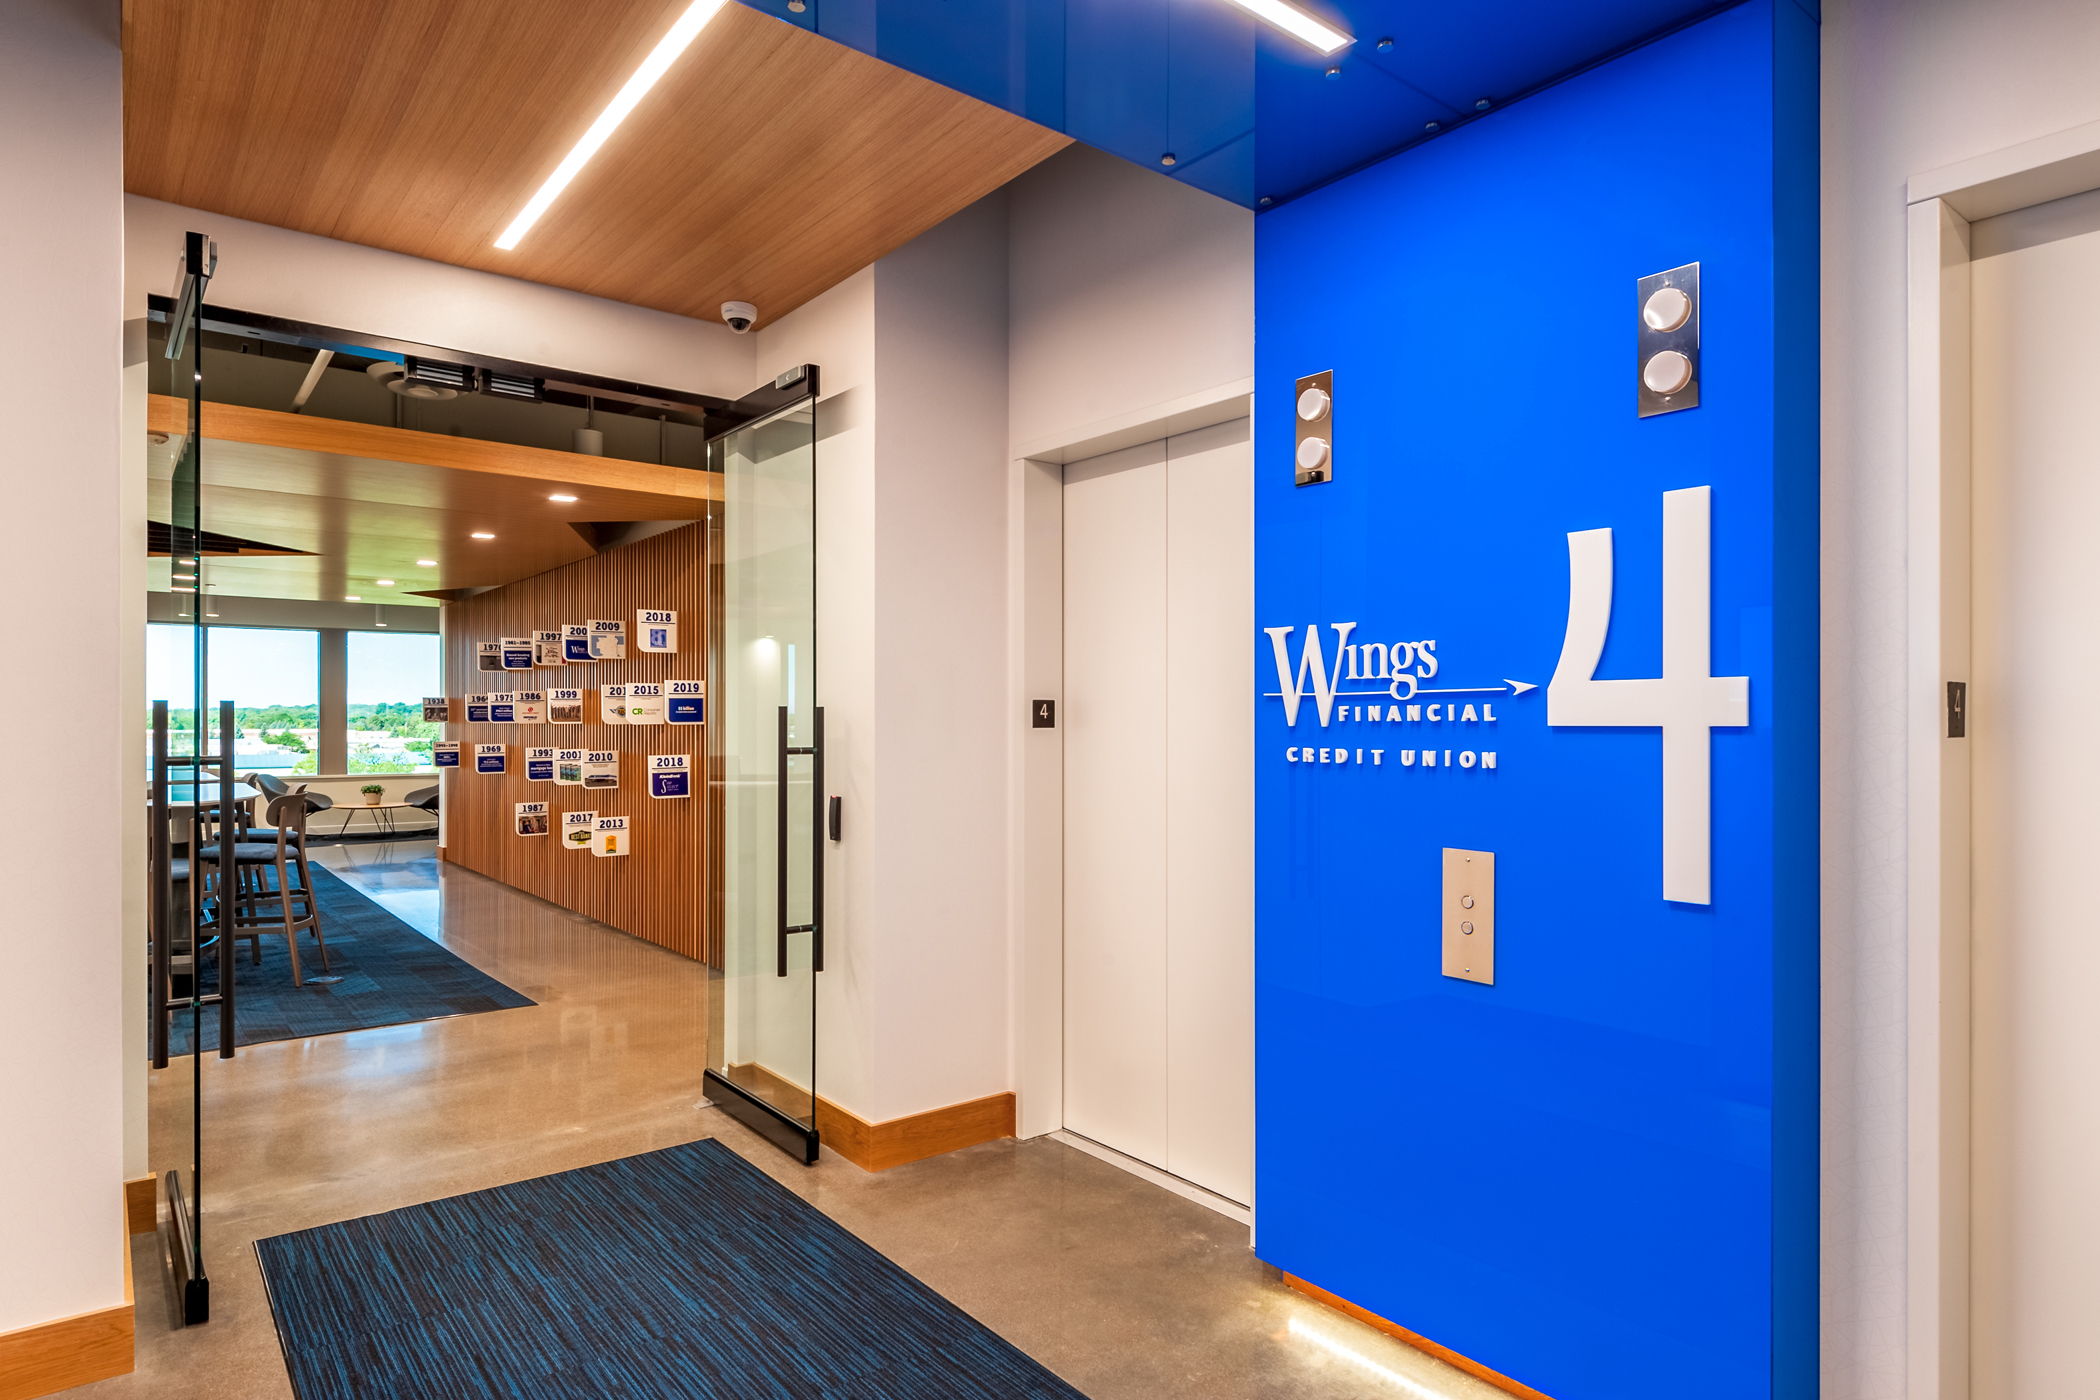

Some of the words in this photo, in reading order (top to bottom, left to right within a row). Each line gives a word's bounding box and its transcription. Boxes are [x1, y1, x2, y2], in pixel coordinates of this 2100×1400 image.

[645, 612, 672, 622] 2018
[595, 621, 620, 631] 2009
[570, 627, 587, 635] 200
[540, 632, 562, 641] 1997
[1263, 621, 1438, 727] Wings
[609, 687, 626, 695] 201
[633, 685, 659, 694] 2015
[673, 682, 699, 692] 2019
[519, 692, 541, 700] 1986
[555, 690, 577, 698] 1999
[1547, 485, 1749, 905] 4
[1954, 689, 1961, 719] 4
[632, 707, 643, 715] CR
[1039, 703, 1049, 719] 4
[1338, 703, 1497, 722] FINANCIAL
[588, 752, 613, 761] 2010
[1286, 747, 1384, 766] CREDIT
[1401, 749, 1497, 769] UNION
[656, 757, 683, 767] 2018
[522, 804, 543, 812] 1987
[569, 814, 593, 822] 2017
[599, 819, 624, 828] 2013
